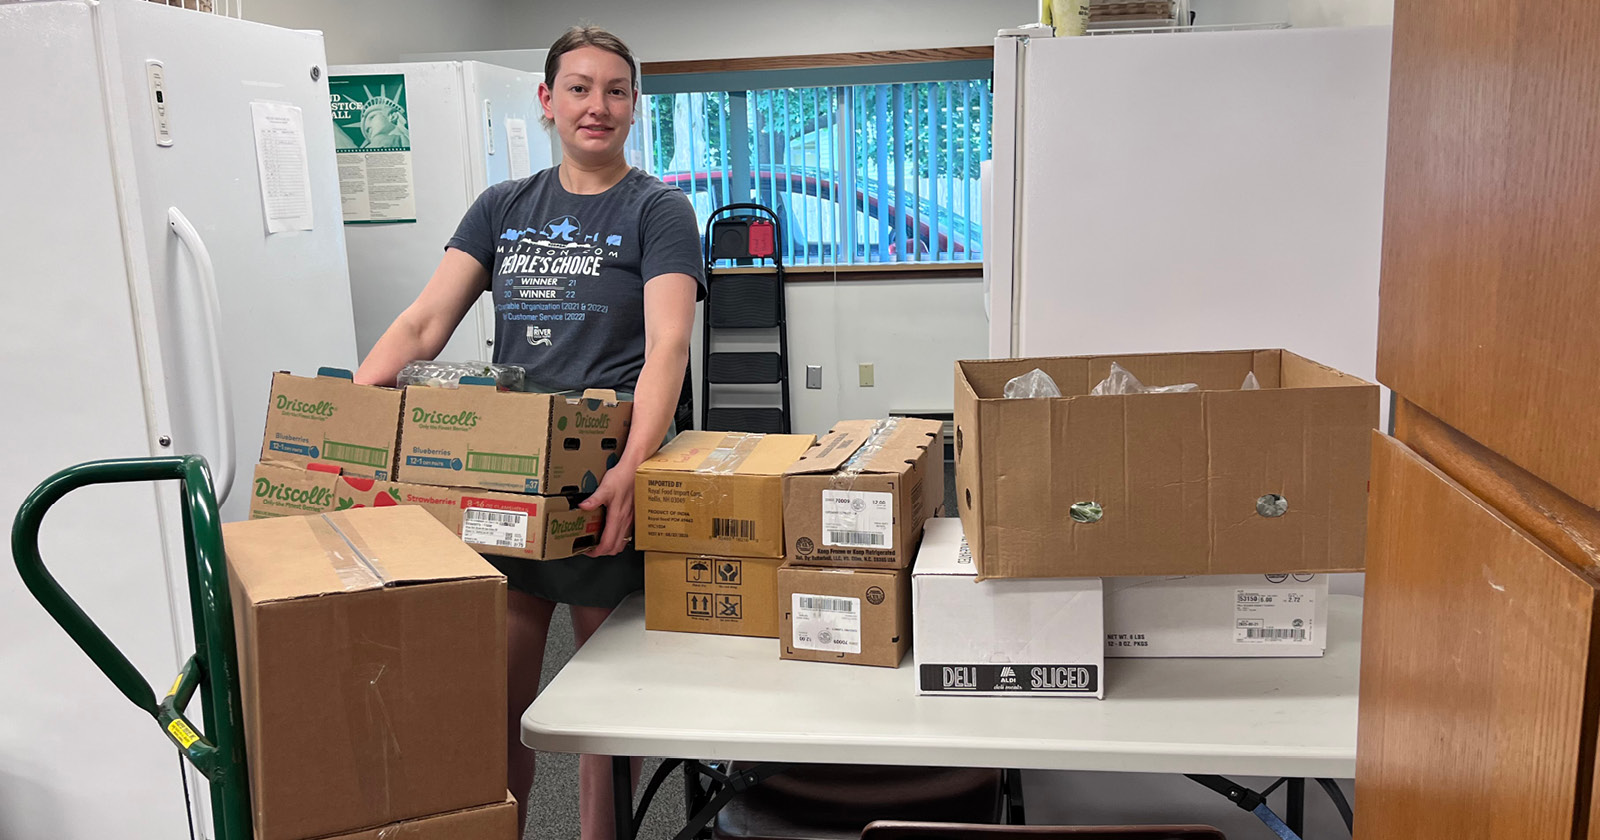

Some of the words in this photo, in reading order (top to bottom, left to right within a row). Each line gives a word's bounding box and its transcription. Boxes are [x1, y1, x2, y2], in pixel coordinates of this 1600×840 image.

[551, 255, 603, 276] CHOICE
[504, 279, 514, 287] 20
[521, 277, 559, 287] WINNER
[568, 279, 577, 287] 21
[504, 290, 512, 298] 20
[519, 289, 557, 299] WINNER
[565, 291, 576, 299] 22
[521, 302, 560, 312] Organization
[580, 303, 587, 311] &
[508, 313, 538, 321] Customer
[540, 313, 563, 321] Service
[276, 394, 335, 417] Driscoll's
[412, 407, 479, 427] Driscoll's
[275, 432, 309, 443] Blueberries
[413, 446, 451, 456] Blueberries
[648, 480, 675, 488] IMPORTED
[255, 477, 333, 507] Driscoll's
[648, 487, 660, 495] Royal
[673, 489, 690, 497] Import
[407, 494, 456, 506] Strawberries
[942, 666, 977, 688] DELI
[1031, 667, 1090, 688] SLICED
